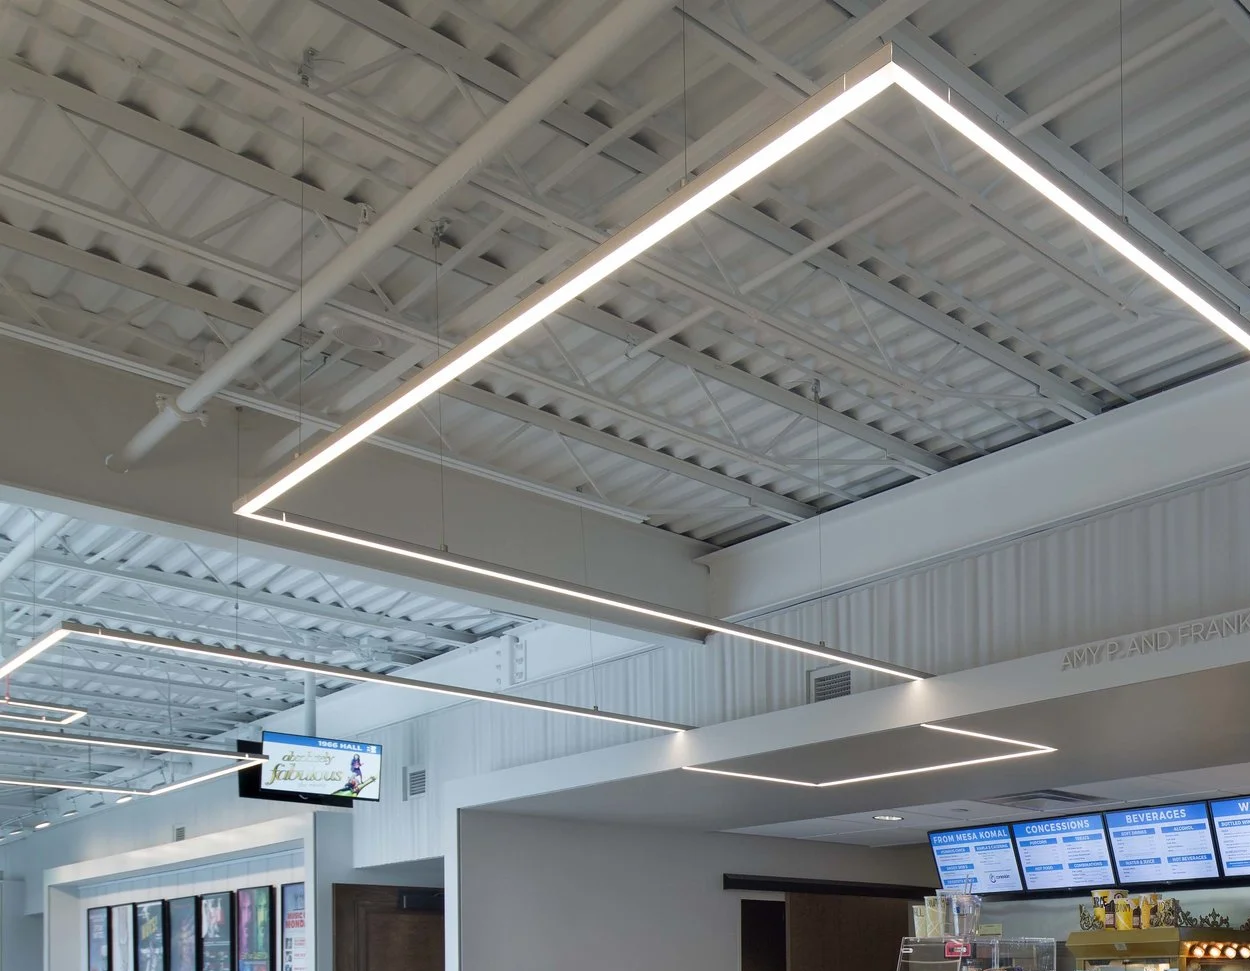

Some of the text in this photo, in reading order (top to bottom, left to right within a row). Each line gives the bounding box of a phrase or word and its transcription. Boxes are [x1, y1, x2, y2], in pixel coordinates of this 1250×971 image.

[1061, 647, 1099, 669] AMY
[1106, 641, 1122, 660] P.
[1127, 630, 1171, 653] AND
[318, 740, 363, 751] 1966 HALL
[265, 763, 344, 785] fabulous
[1125, 809, 1187, 824] BEVERAGES
[1025, 819, 1090, 834] CONCESSIONS
[933, 829, 1008, 844] FROM MESA KOMAL
